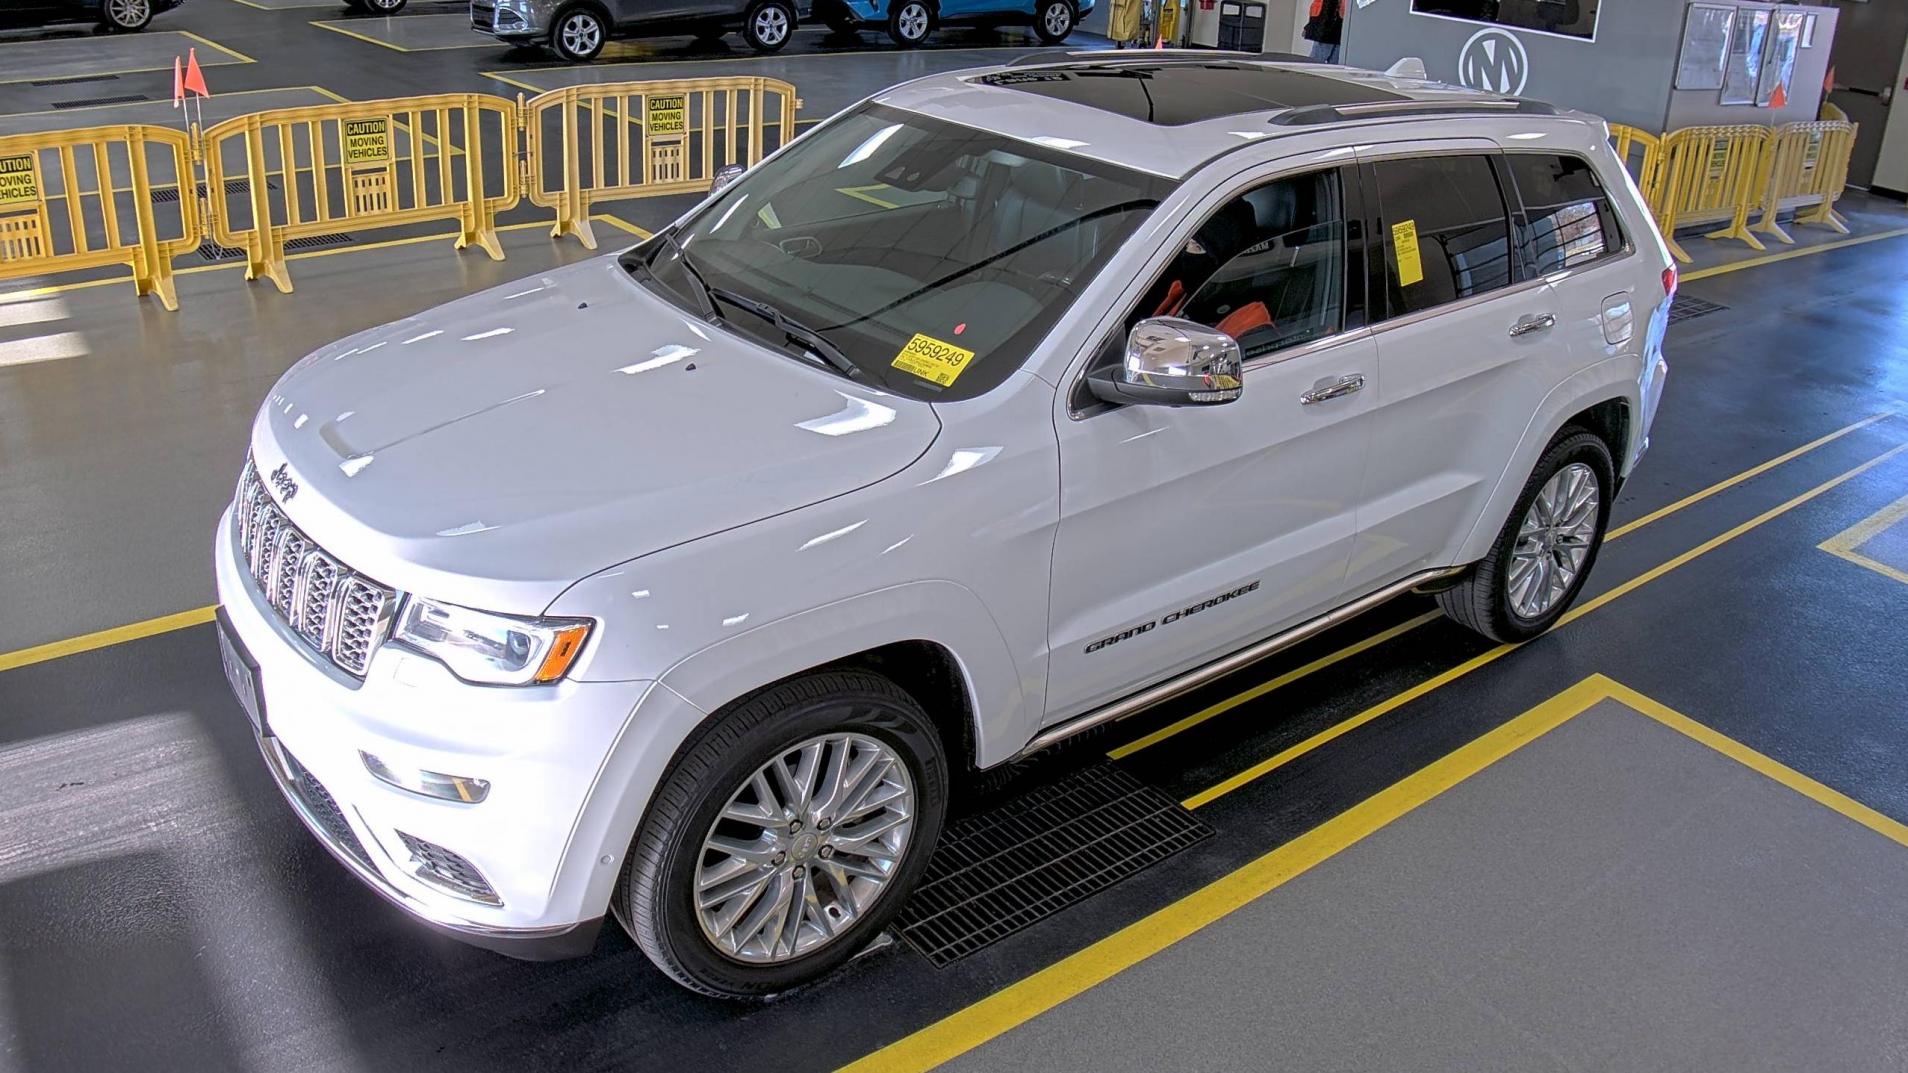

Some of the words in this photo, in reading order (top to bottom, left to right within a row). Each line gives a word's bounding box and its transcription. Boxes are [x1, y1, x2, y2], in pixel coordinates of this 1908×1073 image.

[650, 98, 684, 110] CAUTION
[651, 111, 681, 122] MOVING
[347, 121, 385, 135] CAUTION
[649, 121, 684, 132] VEHICLES
[350, 135, 384, 148] MOVING
[346, 146, 387, 159] VEHICLES
[0, 158, 31, 172] UTION
[0, 174, 32, 187] OVING
[0, 186, 37, 199] HICLES
[907, 338, 965, 367] 5959249
[1085, 620, 1157, 653] GRAND
[1161, 579, 1261, 625] CHEROKEE
